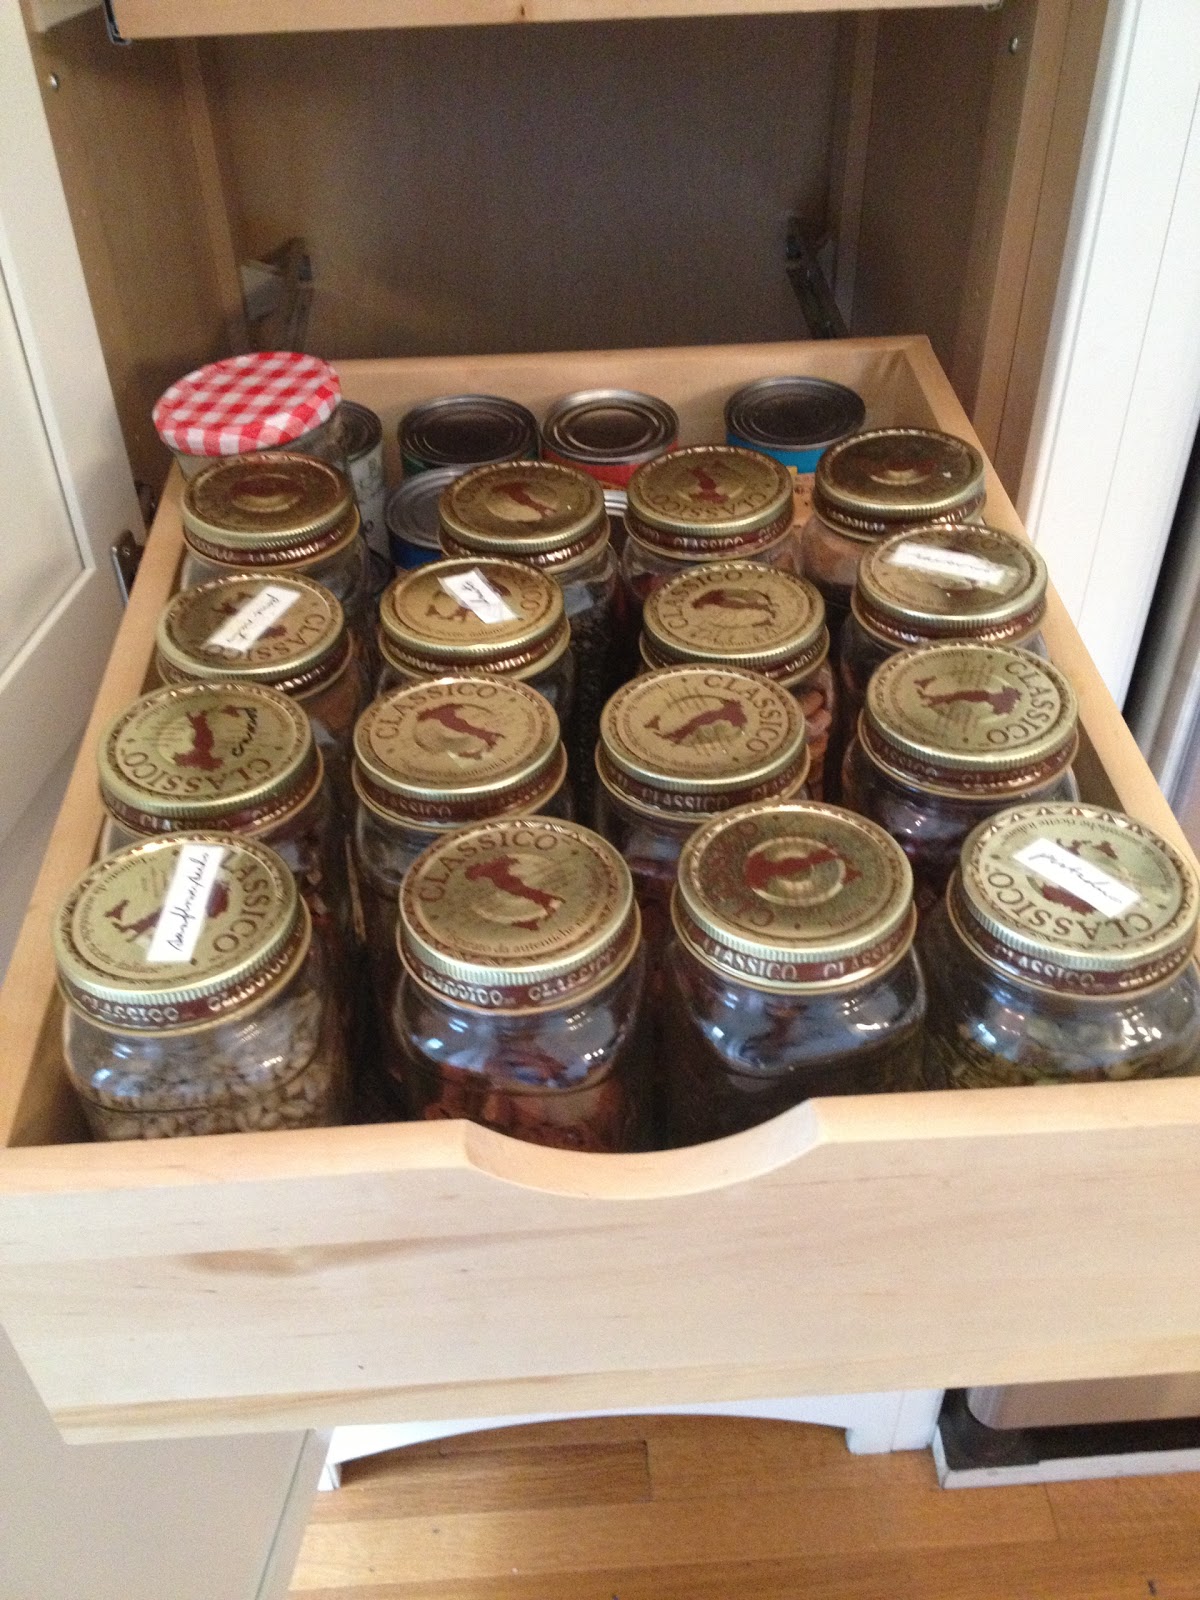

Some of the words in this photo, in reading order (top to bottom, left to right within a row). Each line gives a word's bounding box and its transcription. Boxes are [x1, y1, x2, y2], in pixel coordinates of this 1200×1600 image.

[651, 492, 767, 518] CLASSICO
[663, 570, 743, 629] CLASSICO
[375, 682, 498, 741] CLASSICO
[703, 674, 782, 751] CLASSICO
[986, 660, 1055, 744] CLASSICO
[123, 751, 272, 791] CLASSICO
[418, 828, 559, 904] CLASSICO
[213, 849, 271, 953] LASSICO
[986, 870, 1154, 941] CLASSICO
[702, 936, 799, 981] CLASSICO
[81, 993, 180, 1022] CLASSICO
